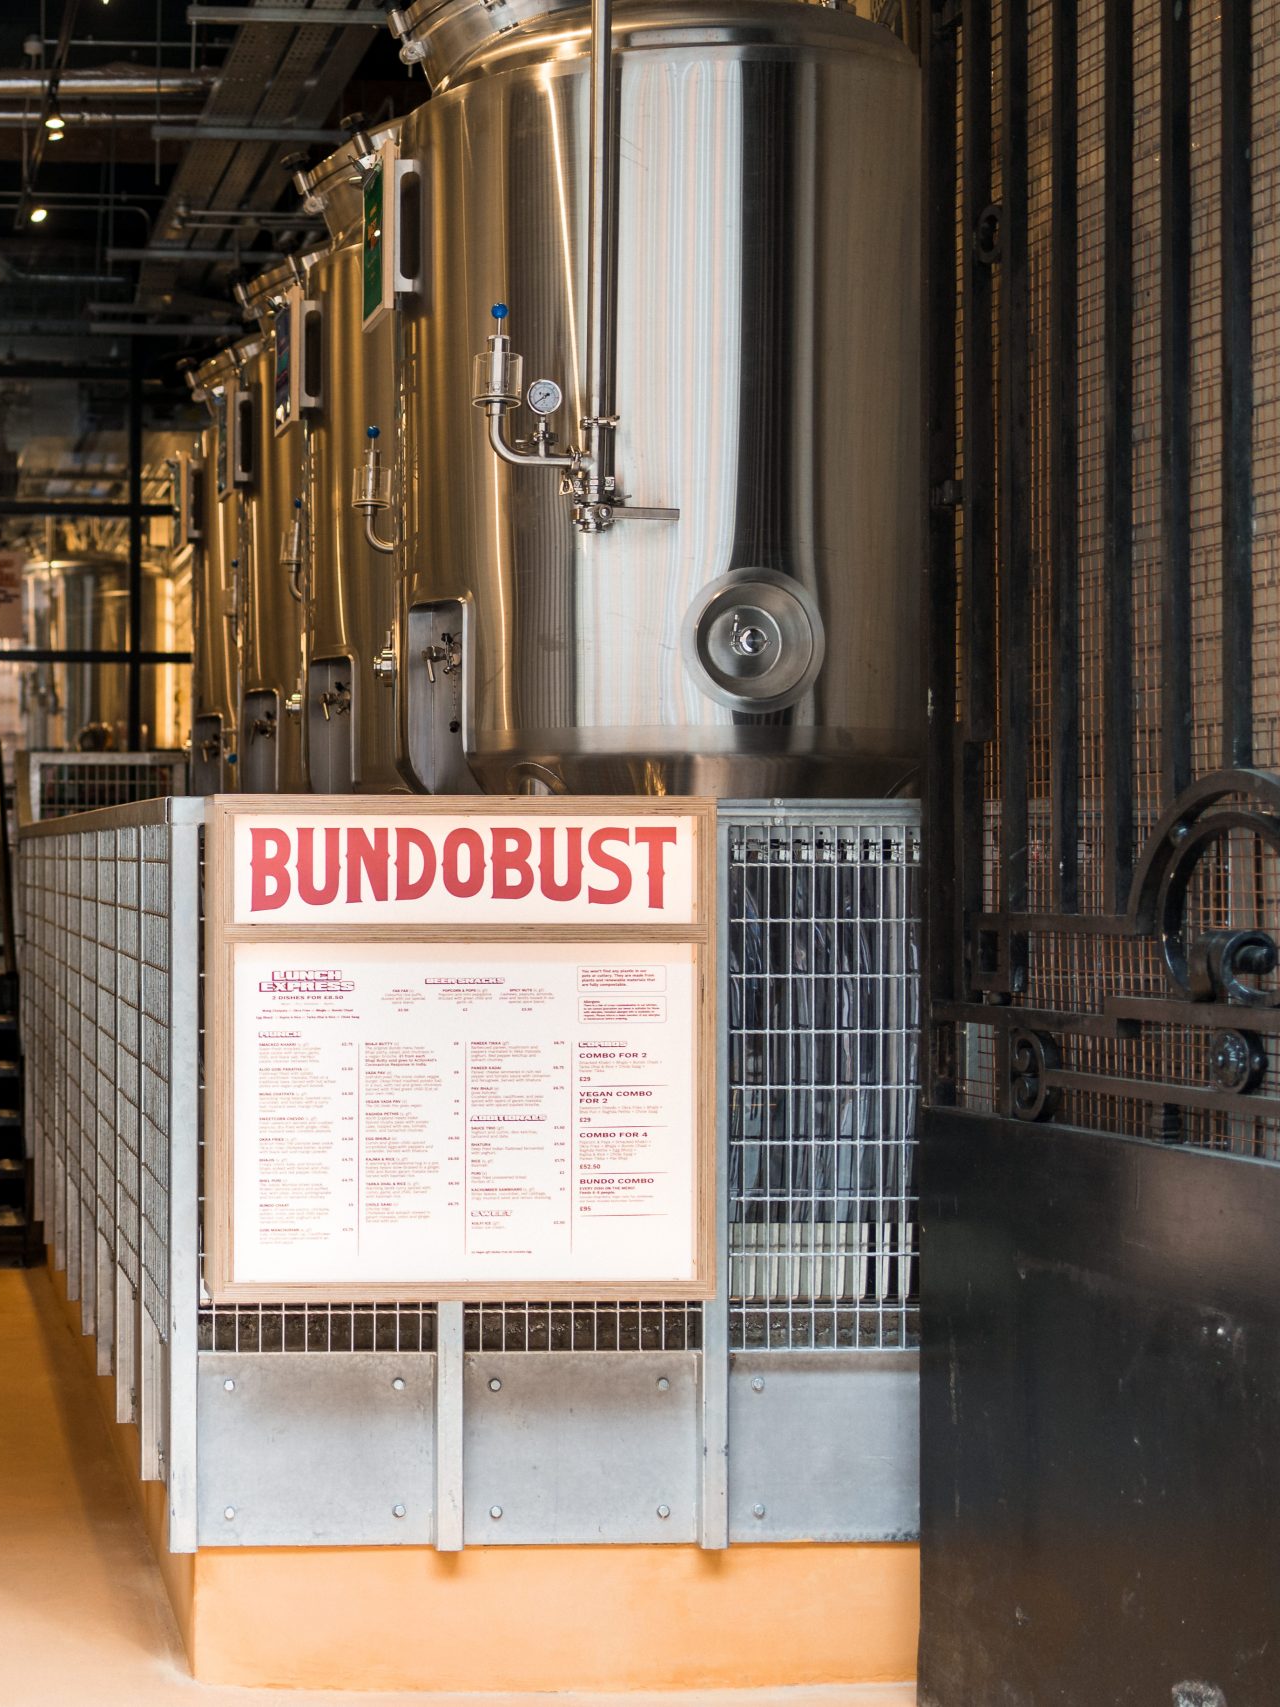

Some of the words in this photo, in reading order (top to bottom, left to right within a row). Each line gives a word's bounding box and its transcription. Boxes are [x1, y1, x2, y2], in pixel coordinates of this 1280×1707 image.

[250, 826, 677, 912] BUNDOBUST
[271, 969, 342, 981] LUNCH
[259, 981, 355, 992] EXPRESS
